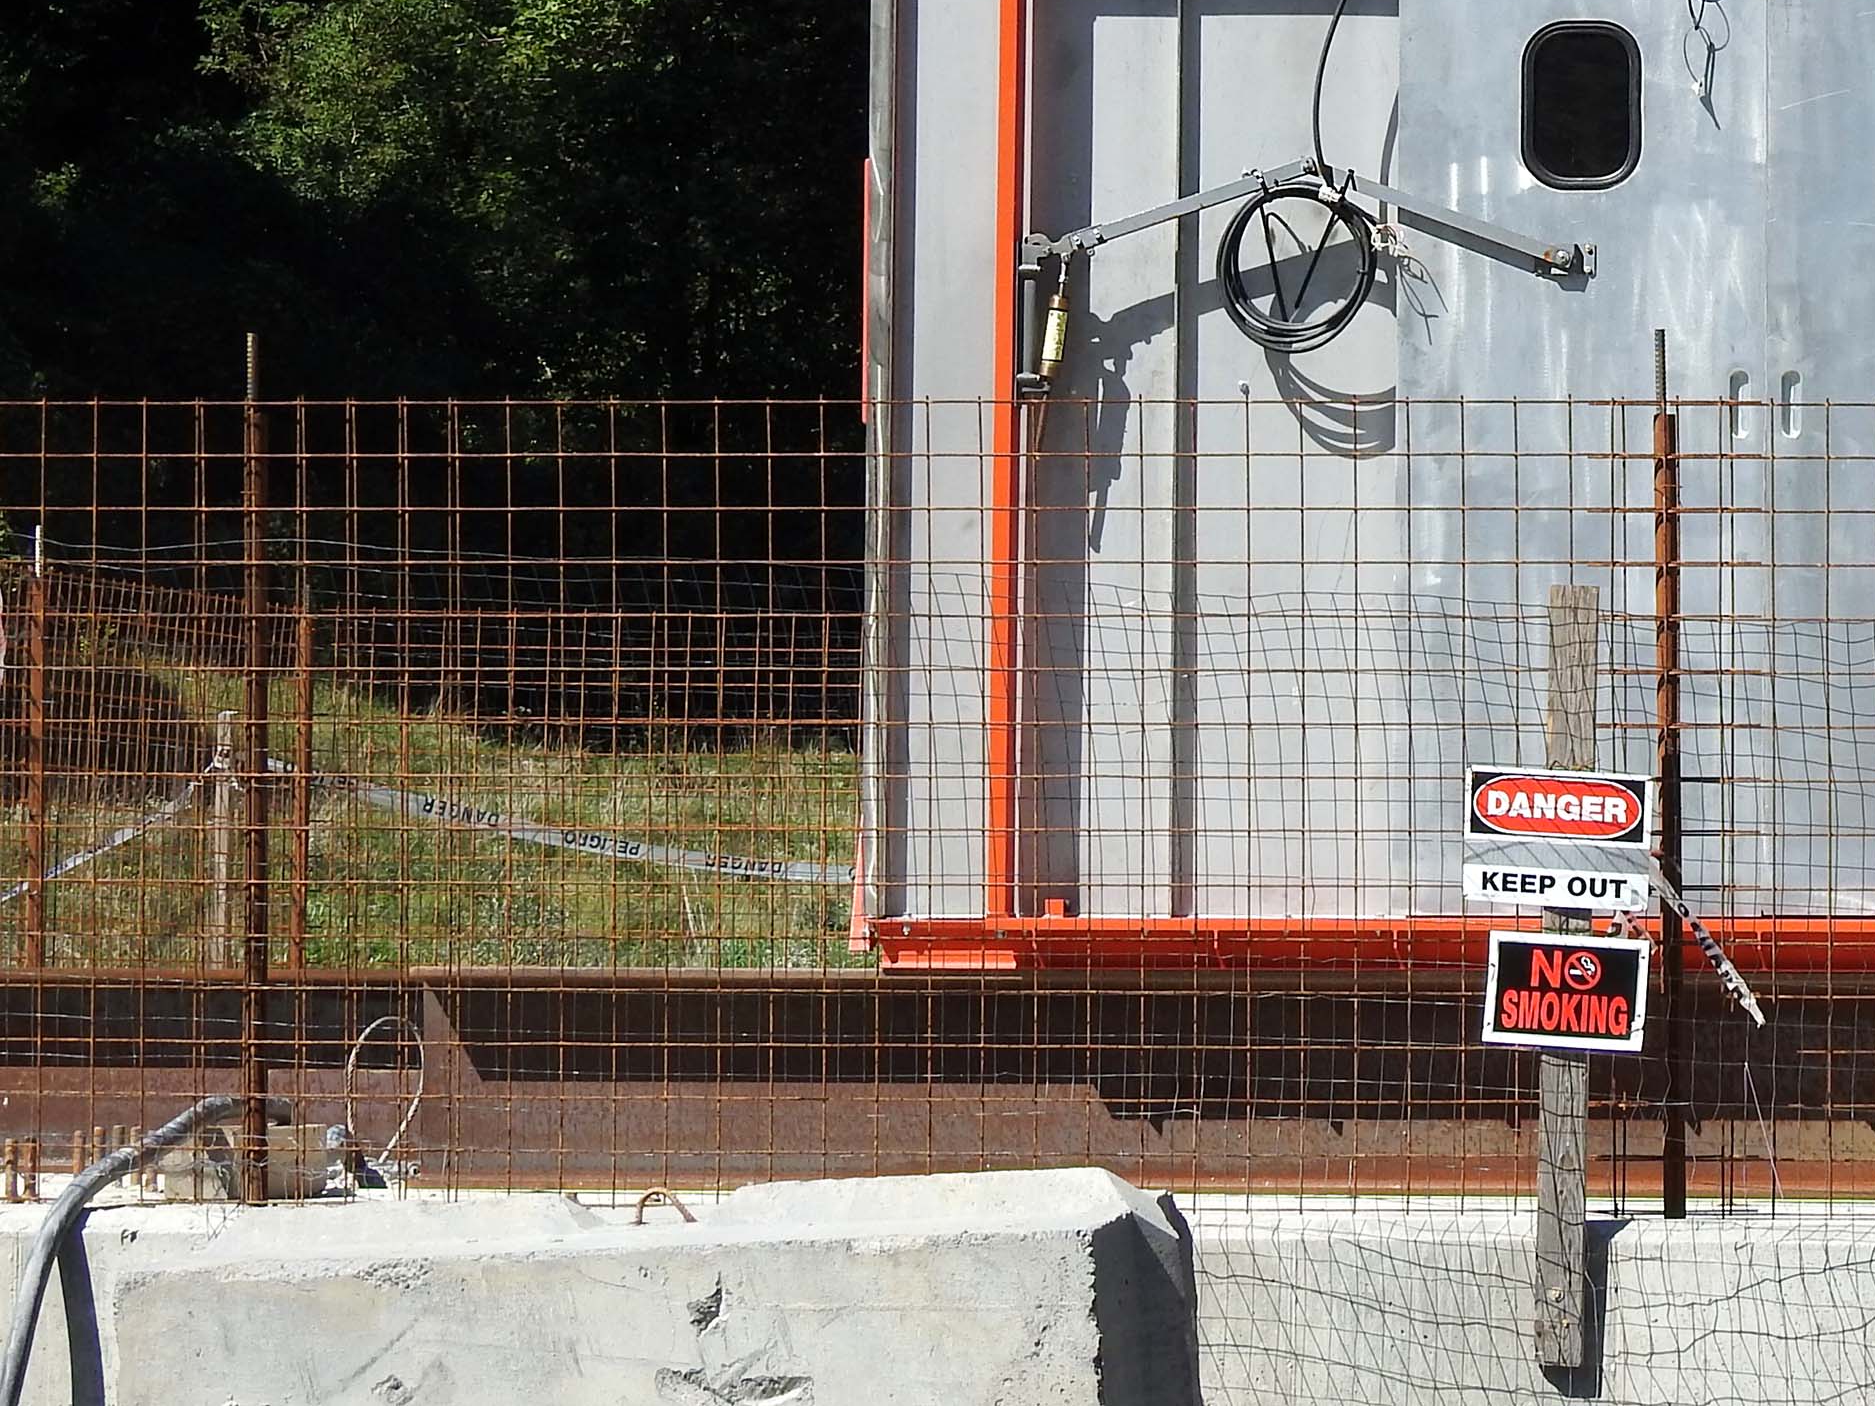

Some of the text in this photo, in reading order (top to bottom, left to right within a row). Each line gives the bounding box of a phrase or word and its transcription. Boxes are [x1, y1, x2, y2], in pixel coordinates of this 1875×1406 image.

[422, 796, 500, 828] DANGER
[1486, 789, 1628, 825] DANGER
[1481, 870, 1628, 899] KEEP OUT
[1500, 989, 1630, 1036] SMOKING
